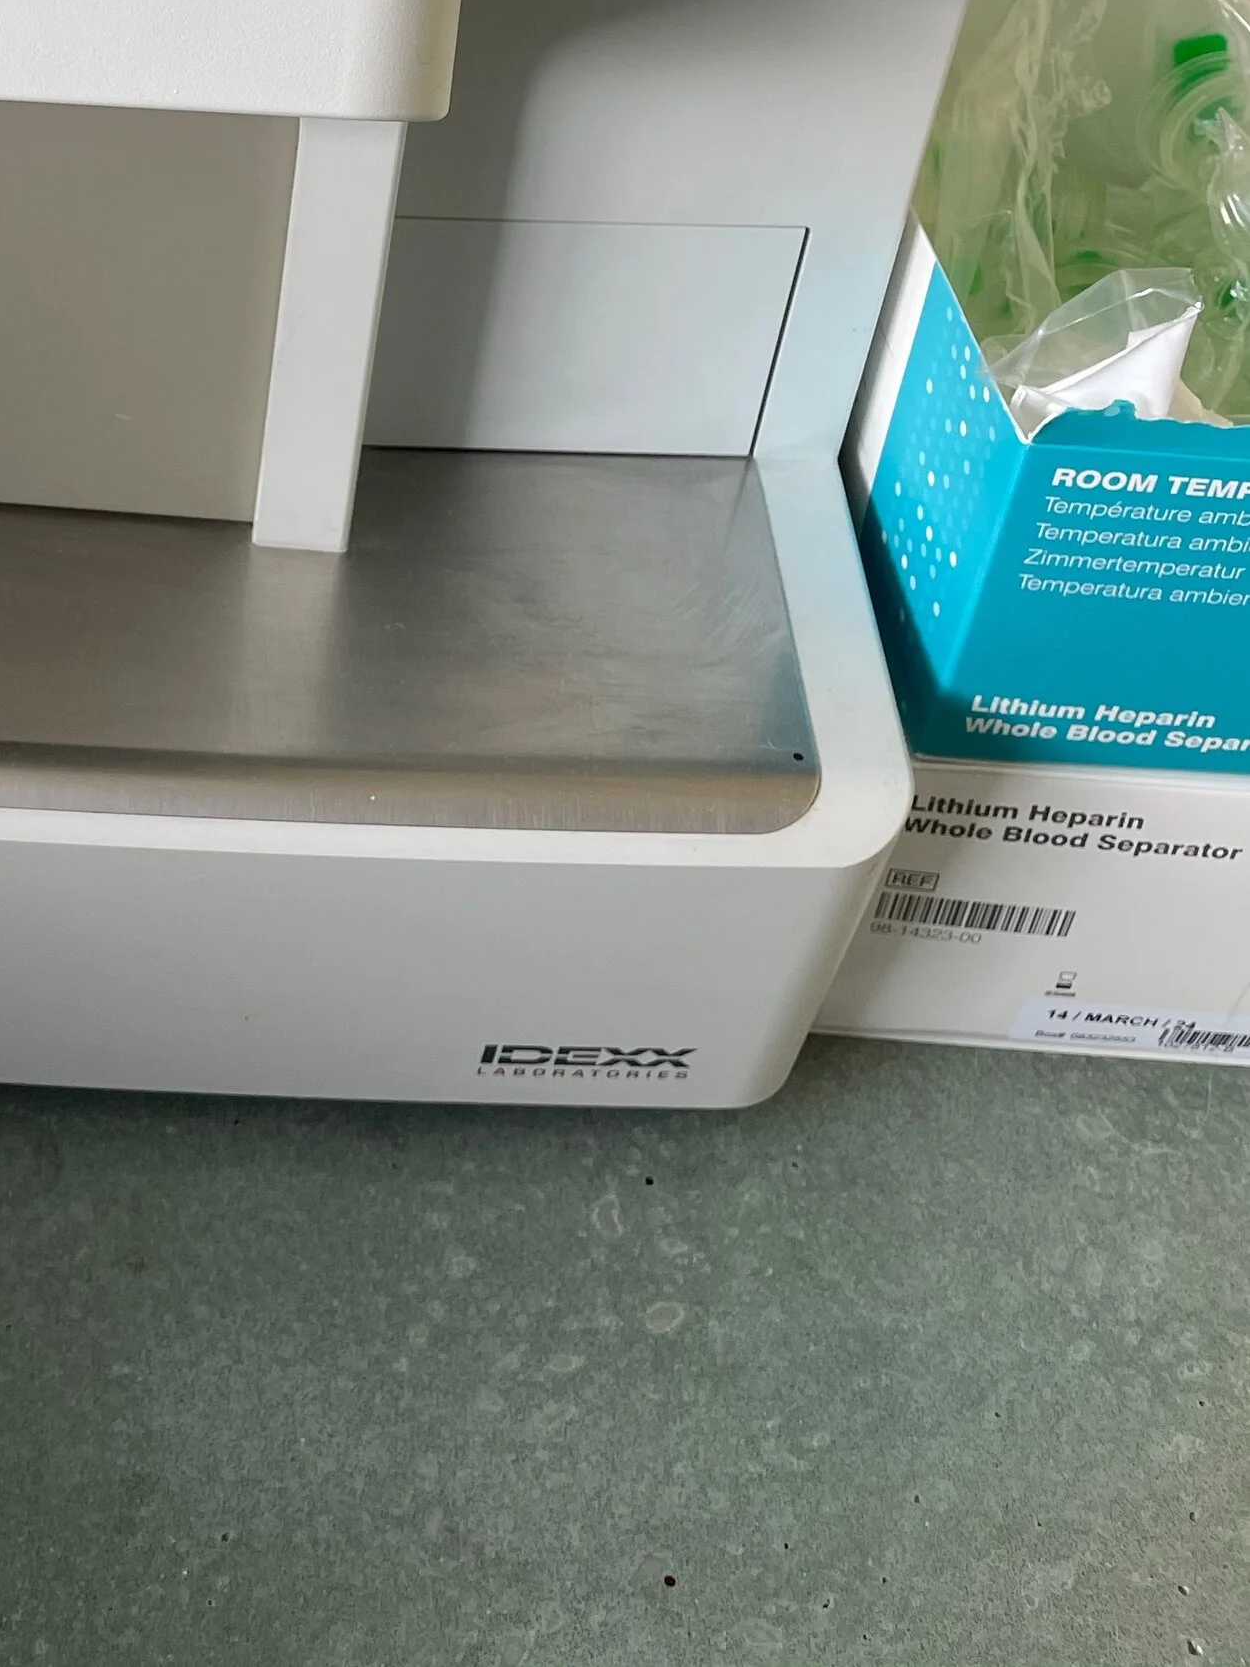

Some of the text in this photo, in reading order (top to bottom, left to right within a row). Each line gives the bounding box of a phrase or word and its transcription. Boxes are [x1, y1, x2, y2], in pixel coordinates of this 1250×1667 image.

[1051, 467, 1159, 493] ROOM
[1045, 496, 1192, 523] Température
[1036, 523, 1182, 550] Temperatura
[1023, 548, 1246, 580] Zimmertemperatur
[1018, 573, 1162, 601] Temperatura
[971, 694, 1216, 729] Lithium Heparin
[965, 716, 1057, 740] Whole
[1066, 724, 1158, 746] Blood
[911, 794, 1145, 831] Lithium Heparin
[905, 816, 1243, 861] Whole Blood Separator
[1085, 1012, 1158, 1028] MARCH
[480, 1044, 698, 1068] IDEXX
[476, 1066, 690, 1080] LABORATORIES
